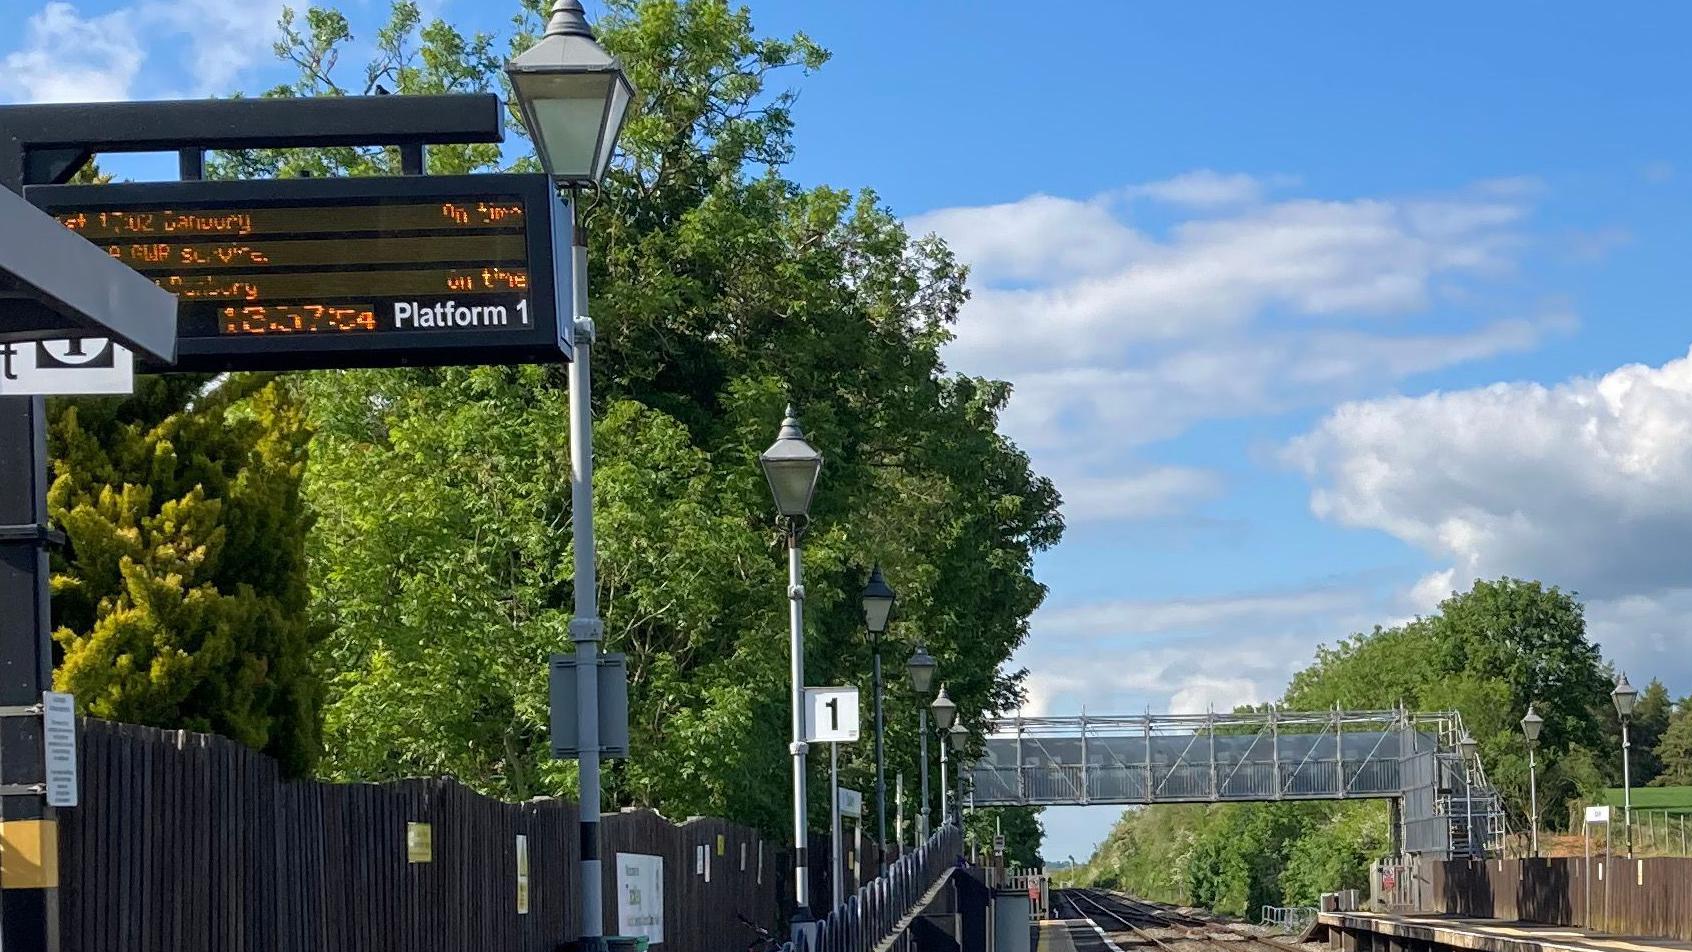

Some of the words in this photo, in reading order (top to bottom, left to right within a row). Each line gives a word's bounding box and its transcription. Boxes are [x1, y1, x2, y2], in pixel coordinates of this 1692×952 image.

[394, 300, 508, 329] Platform
[516, 298, 529, 325] 1
[825, 697, 839, 731] 1
